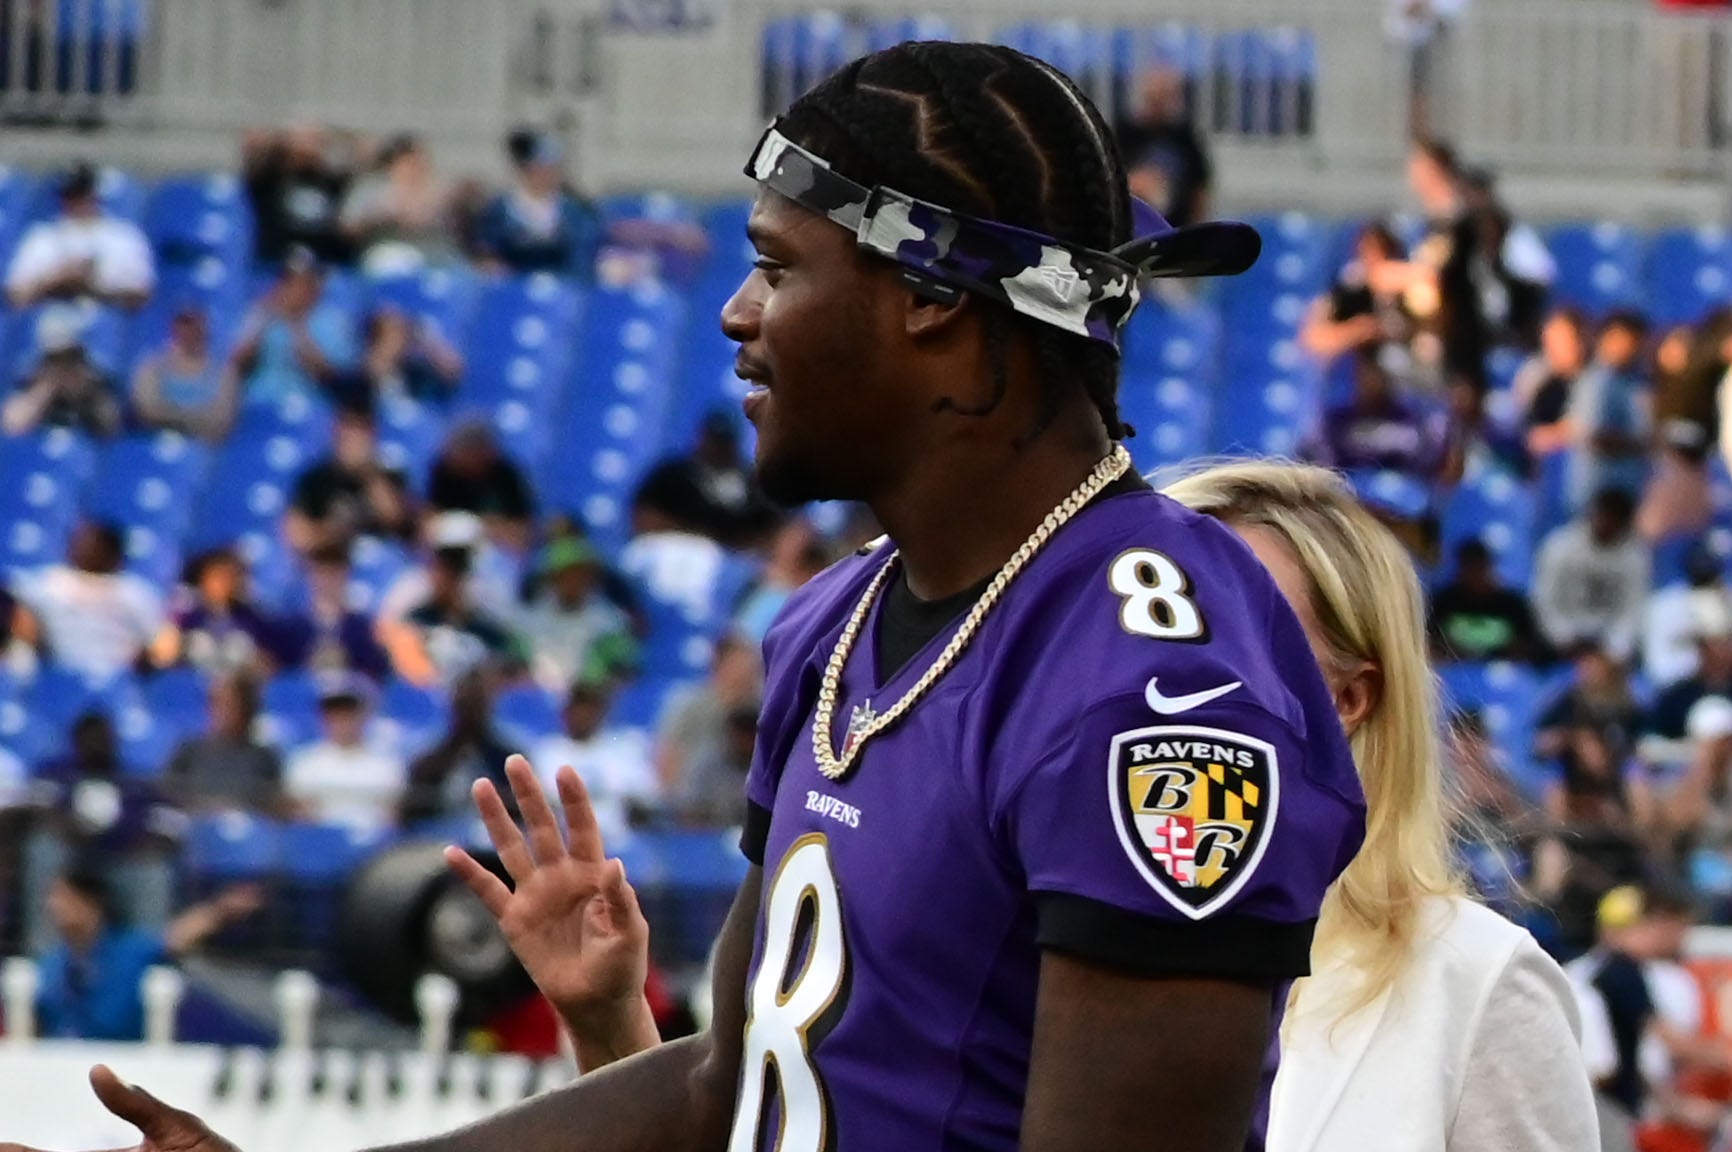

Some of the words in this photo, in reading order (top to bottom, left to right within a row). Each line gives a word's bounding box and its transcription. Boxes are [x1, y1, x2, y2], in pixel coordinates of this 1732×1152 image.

[1107, 547, 1207, 641] 8
[1130, 741, 1254, 768] RAVENS
[805, 790, 862, 828] RAVENS
[1133, 763, 1198, 814] B
[1193, 821, 1246, 872] R
